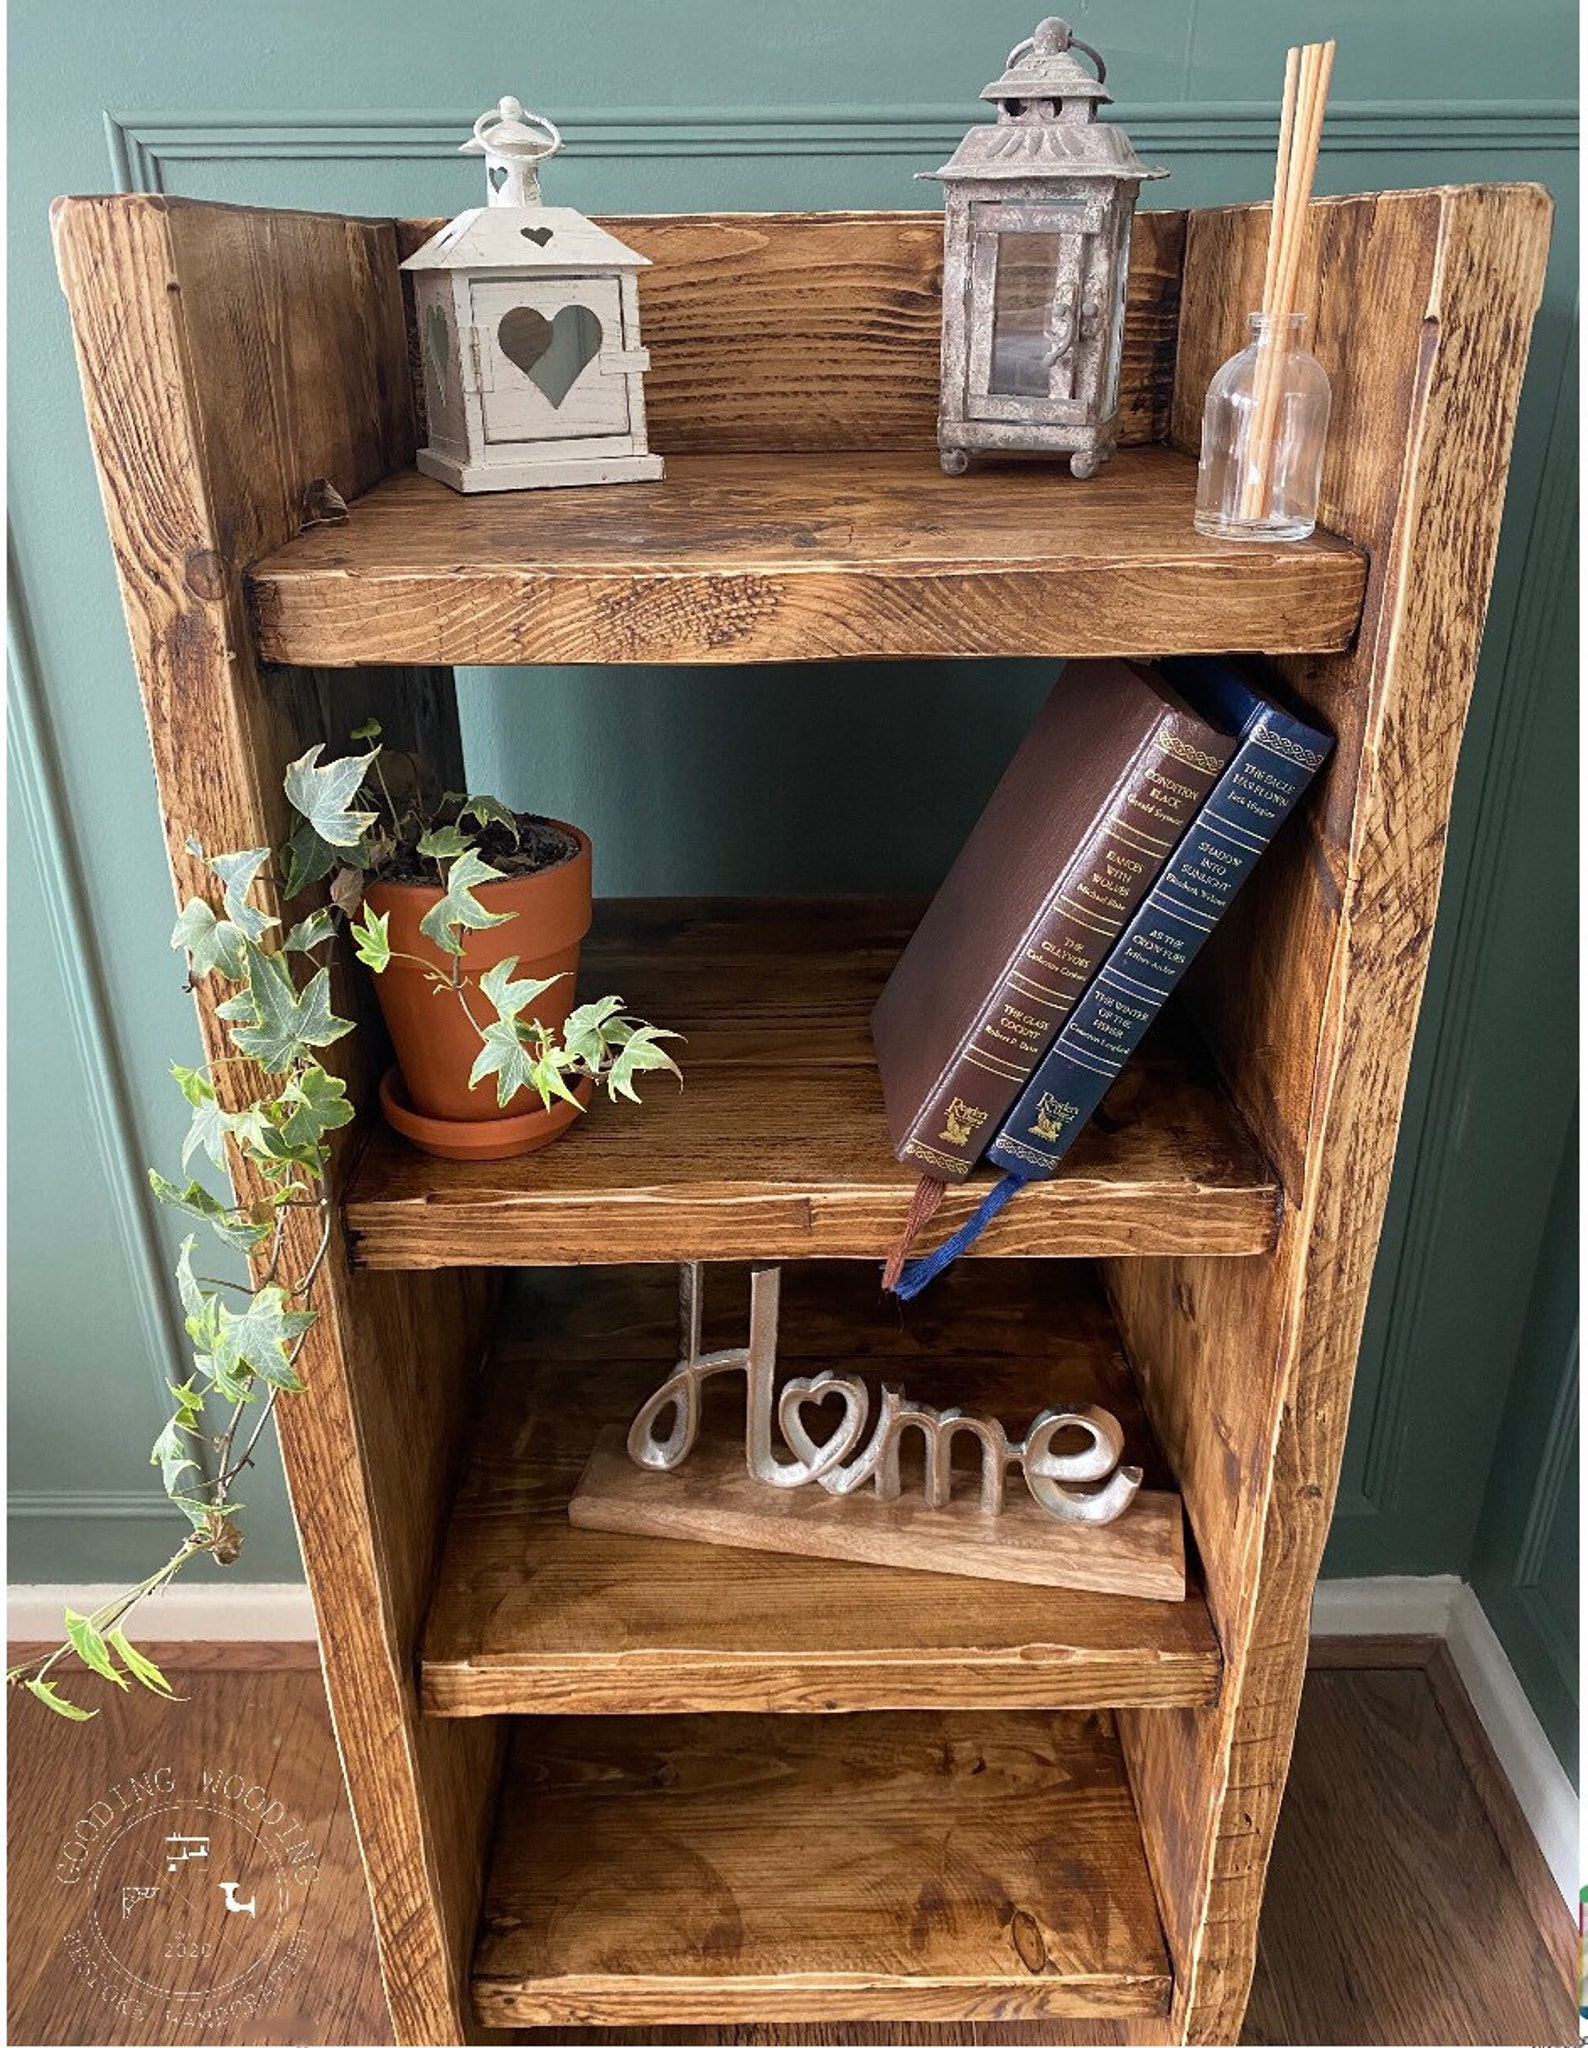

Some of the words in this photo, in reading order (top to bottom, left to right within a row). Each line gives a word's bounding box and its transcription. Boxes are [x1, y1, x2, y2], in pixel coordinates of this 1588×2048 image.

[1244, 762, 1266, 779] THE
[1144, 769, 1199, 800] CONDITION
[1149, 788, 1181, 809] BLACK
[1106, 864, 1132, 883] WITH
[1200, 858, 1226, 876] INTO
[1149, 929, 1164, 940] AS
[1064, 936, 1085, 953] THE
[1095, 990, 1115, 1007] THE
[1004, 1004, 1024, 1020] THE
